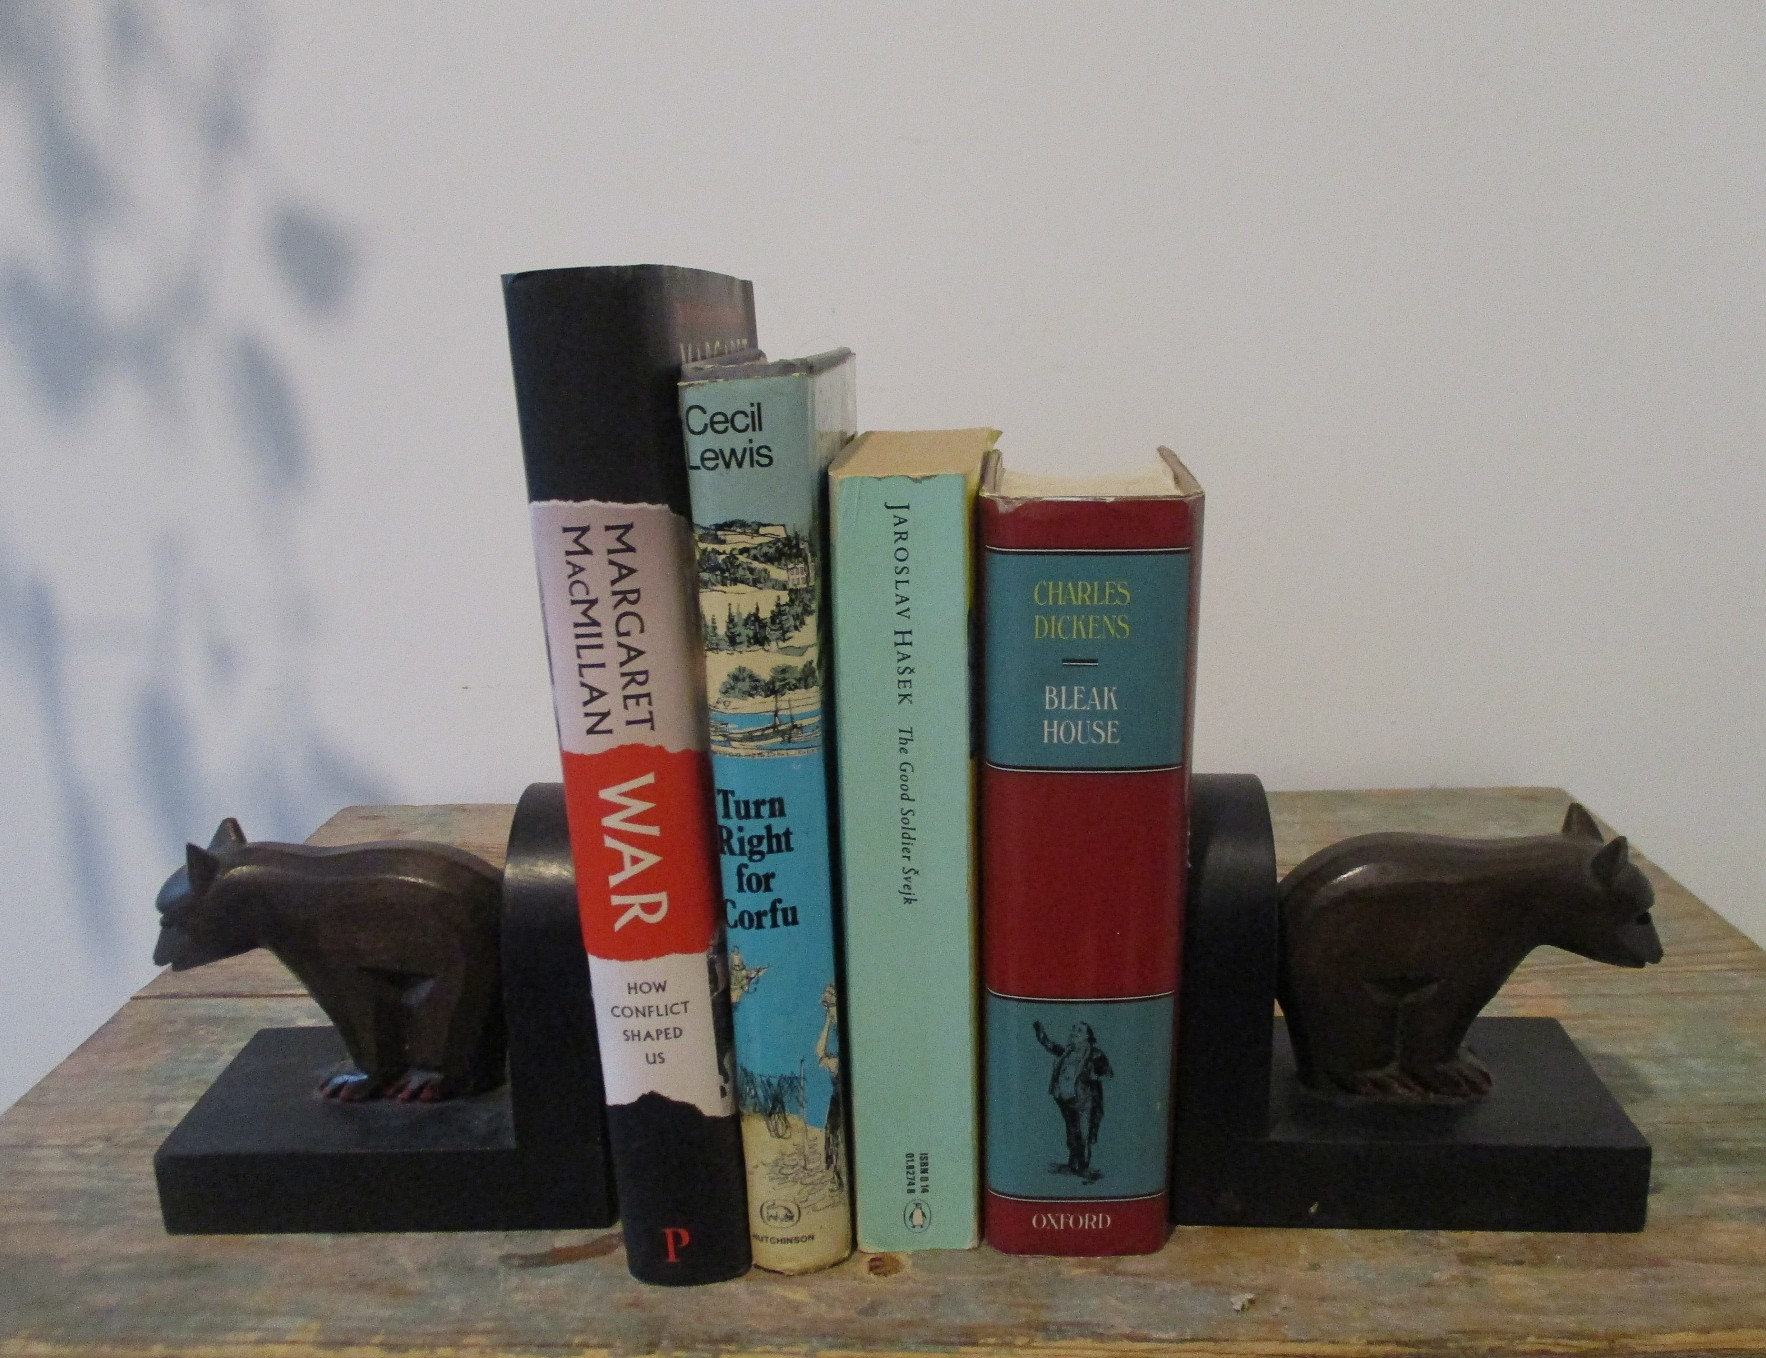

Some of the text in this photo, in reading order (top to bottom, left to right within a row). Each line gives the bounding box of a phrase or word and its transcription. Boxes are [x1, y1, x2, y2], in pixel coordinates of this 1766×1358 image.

[685, 402, 763, 436] Cecil
[1033, 580, 1131, 606] CHARLES
[604, 522, 655, 732] MARGARET
[1034, 614, 1131, 640] DICKENS
[884, 501, 920, 905] JAROSLAV HAŠEK The Good Soldier Švejk
[1044, 685, 1118, 711] BLEAK
[1042, 719, 1121, 745] HOUSE
[716, 788, 787, 820] Turn
[598, 771, 669, 933] WAR
[717, 823, 794, 862] Right
[736, 862, 776, 894] for
[724, 897, 800, 931] Corfu
[626, 980, 668, 997] HOW
[610, 1000, 690, 1018] CONFLICT
[622, 1026, 683, 1042] SHAPED
[645, 1051, 666, 1066] US
[919, 1152, 929, 1174] ISBN
[1031, 1212, 1112, 1230] OXFORD
[662, 1227, 691, 1263] P
[752, 1233, 815, 1245] HUTCHINSON
